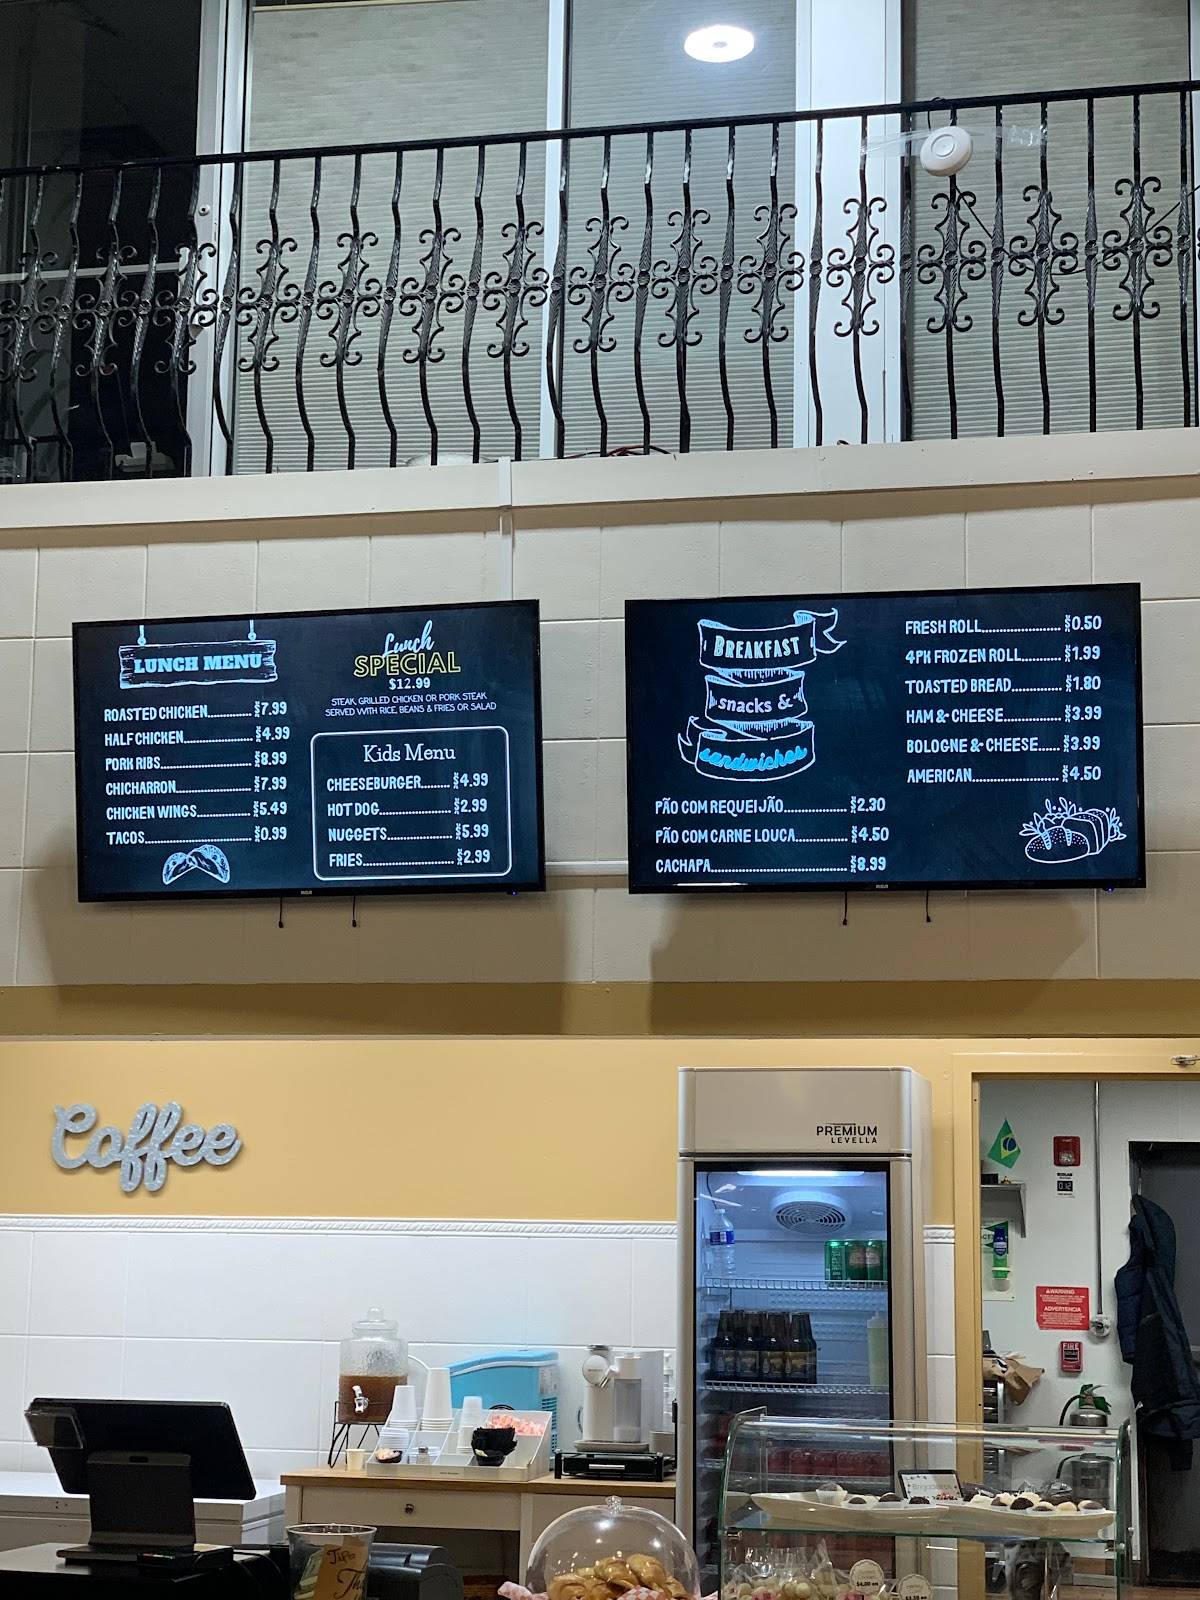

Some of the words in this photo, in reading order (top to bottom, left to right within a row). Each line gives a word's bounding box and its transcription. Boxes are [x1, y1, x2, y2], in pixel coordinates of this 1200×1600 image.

[906, 620, 946, 634] FRESH
[950, 620, 982, 633] ROLL
[1064, 614, 1102, 632] $0.50
[382, 620, 434, 658] Lunch
[714, 635, 799, 659] BREAKFAST
[133, 656, 198, 674] LUNCH
[203, 653, 262, 670] MENU
[905, 650, 931, 664] 4PK
[934, 648, 986, 663] FROZEN
[989, 648, 1022, 662] ROLL
[1064, 644, 1100, 662] $1.99
[353, 652, 461, 677] SPECIAL
[389, 678, 431, 691] $12.99
[905, 679, 968, 694] TOASTED
[970, 678, 1012, 692] BREAD
[1066, 674, 1101, 692] $1.80
[358, 696, 390, 705] GRILLED
[392, 694, 423, 703] CHICKEN
[425, 693, 437, 702] OR
[439, 693, 461, 701] PORK
[462, 692, 487, 700] STEAK
[717, 697, 772, 714] snacks
[777, 694, 793, 708] &
[104, 708, 157, 722] ROASTED
[159, 705, 208, 719] CHICKEN
[254, 701, 287, 717] $7.99
[325, 708, 355, 717] SERVED
[356, 707, 378, 715] WITH
[399, 705, 425, 713] BEANS
[427, 704, 433, 712] &
[434, 703, 455, 712] FRIES
[457, 703, 469, 711] OR
[470, 702, 496, 710] SALAD
[906, 710, 934, 723] HAM
[936, 710, 950, 723] &
[952, 708, 1004, 723] CHEESE
[1064, 705, 1102, 722] $3.99
[104, 732, 133, 746] HALF
[134, 731, 183, 745] CHICKEN
[256, 726, 290, 742] $4.99
[906, 738, 968, 753] BOLOGNE
[970, 739, 984, 752] &
[986, 737, 1039, 752] CHEESE
[1064, 735, 1100, 752] $3.99
[105, 758, 134, 771] PORK
[135, 757, 160, 770] RIBS
[255, 751, 287, 768] $8.99
[363, 745, 400, 762] Kids
[405, 743, 456, 760] Menu
[699, 746, 807, 771] sandwiches
[327, 776, 421, 792] CHEESEBURGER
[454, 772, 488, 789] $4.99
[907, 768, 972, 783] AMERICAN
[1062, 765, 1101, 782] $4.50
[106, 781, 176, 795] CHICHARRON
[254, 776, 287, 792] $7.99
[106, 806, 154, 820] CHICKEN
[157, 805, 196, 818] WINGS
[253, 802, 287, 817] $5.49
[327, 803, 352, 816] HOT
[354, 803, 379, 816] DOG
[454, 798, 487, 814] $2.99
[655, 797, 678, 814] PÃO
[681, 800, 708, 814] COM
[710, 796, 784, 817] REQUEIJÃO
[850, 796, 885, 813] $2.30
[106, 832, 145, 845] TACOS
[255, 827, 287, 842] $0.99
[328, 828, 387, 841] NUGGETS
[455, 823, 488, 840] $5.99
[655, 827, 679, 843] PÃO
[682, 829, 708, 843] COM
[710, 829, 751, 842] CARNE
[755, 828, 795, 842] LOUCA
[852, 826, 889, 843] $4.50
[329, 854, 362, 867] FRIES
[457, 848, 490, 865] $2.99
[656, 859, 711, 873] CACHAPA
[850, 855, 886, 873] $8.99
[816, 1123, 878, 1136] PREMIUM
[52, 1100, 243, 1193] Coffee
